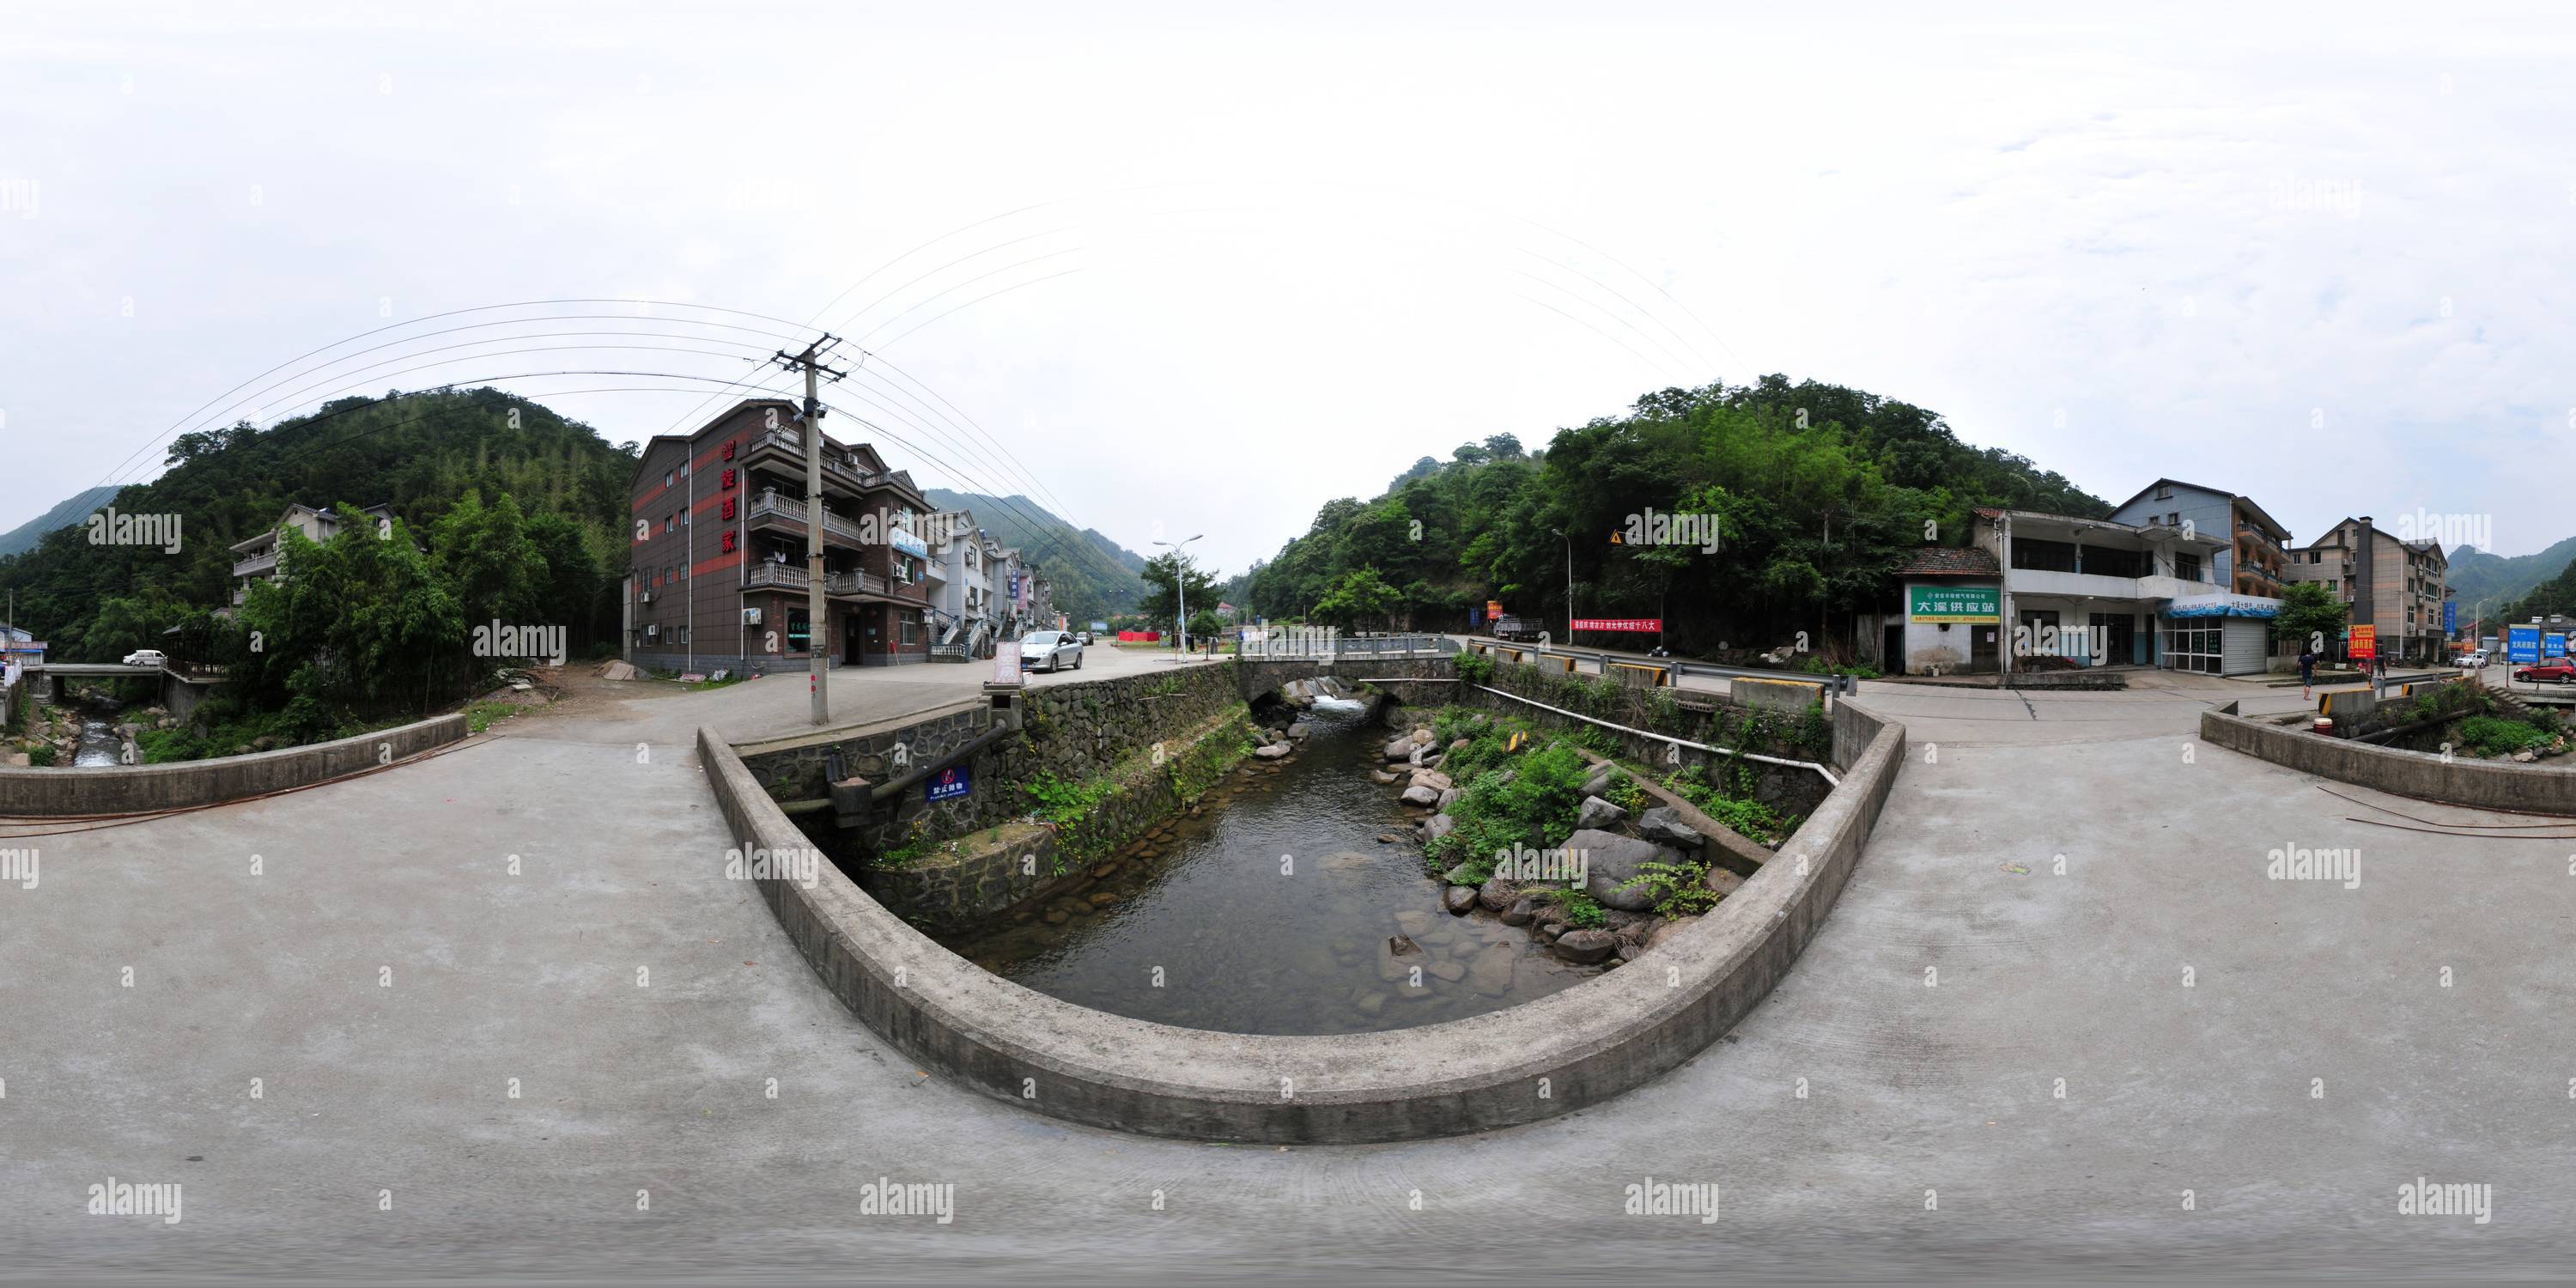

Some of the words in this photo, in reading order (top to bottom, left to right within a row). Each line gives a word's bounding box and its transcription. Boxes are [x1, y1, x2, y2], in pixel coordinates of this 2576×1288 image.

[1917, 601, 1995, 612] 大溪供应站
